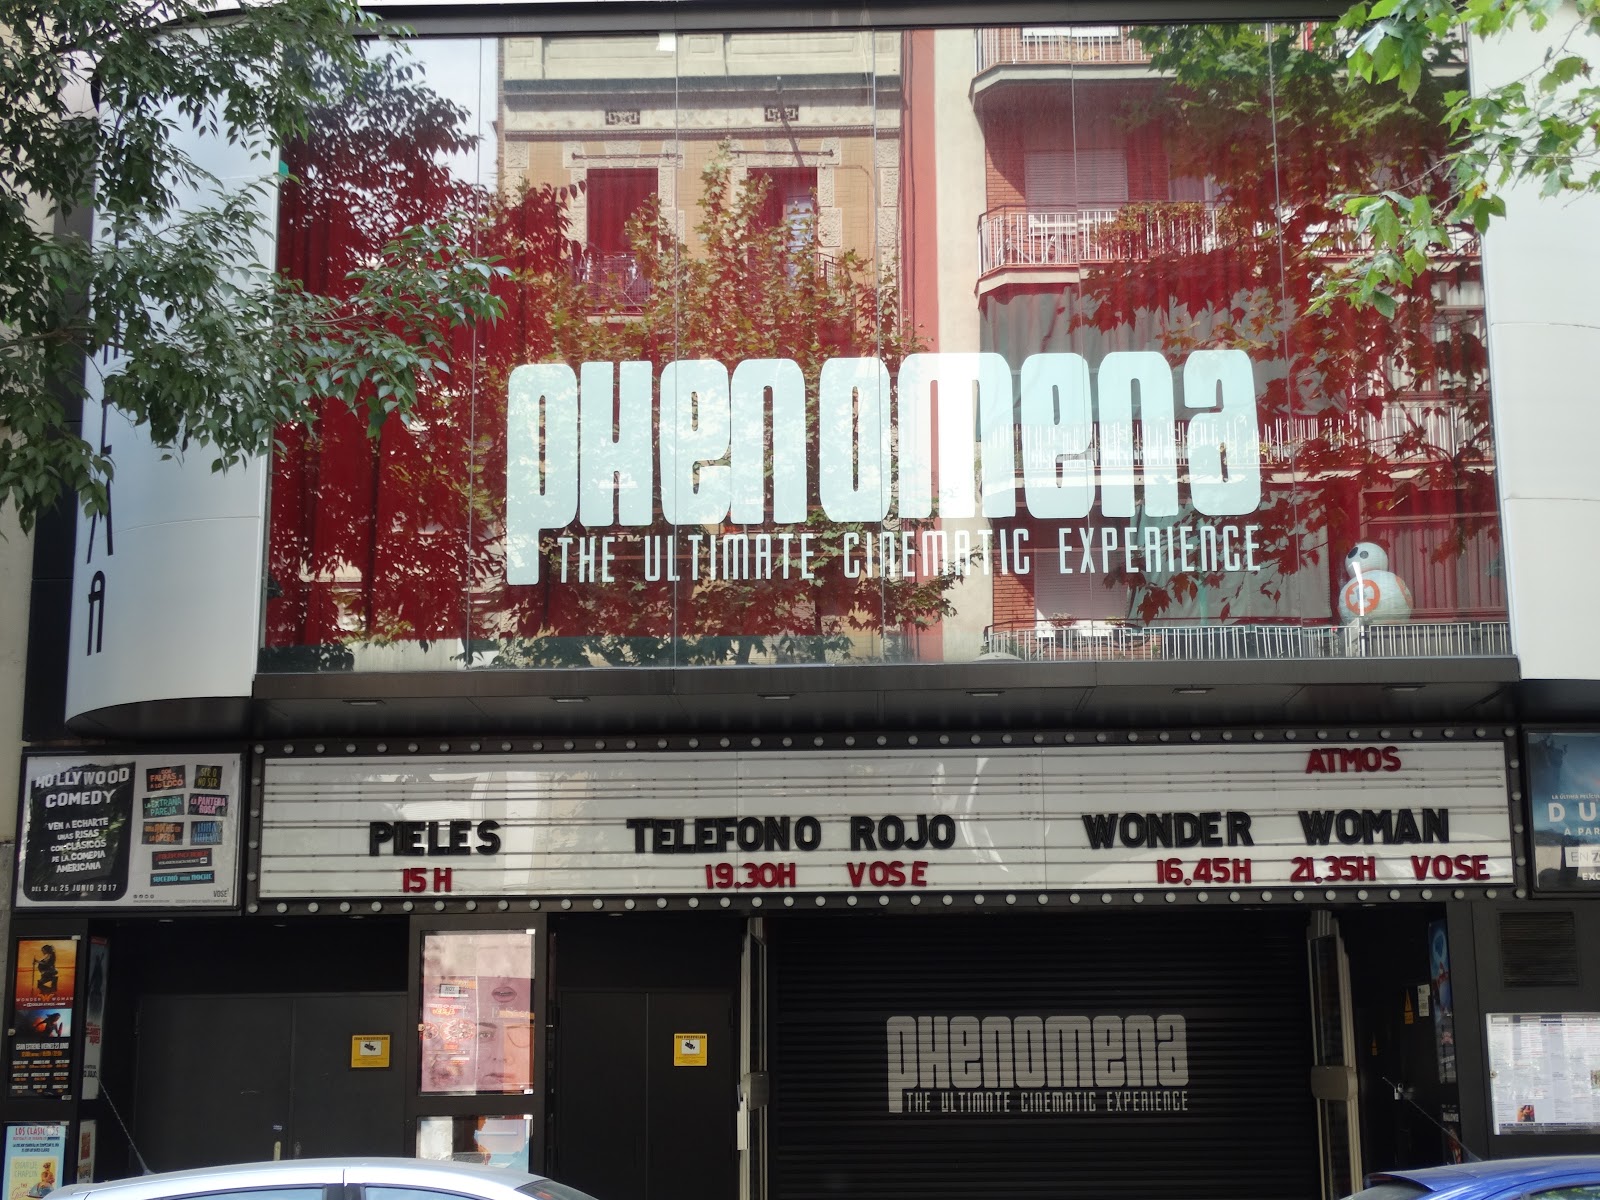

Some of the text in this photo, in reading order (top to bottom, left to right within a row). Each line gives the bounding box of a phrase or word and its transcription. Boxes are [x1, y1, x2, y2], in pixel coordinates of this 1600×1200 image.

[557, 524, 1261, 583] THE ULTIMATE CINEMATIC EXPERIENCE
[1305, 746, 1402, 774] ATMOS
[35, 767, 130, 789] HOLLYWOOD
[162, 779, 184, 788] LOCO
[45, 789, 117, 809] COMEDY
[198, 796, 226, 807] PANTERA
[150, 806, 177, 816] PAREJA
[47, 817, 109, 831] VEN A ECHARTE
[1082, 808, 1449, 850] WONDER WOMAN
[57, 829, 100, 841] UNAS RISAS
[369, 814, 956, 856] PIELES TELEFONO ROJO
[1564, 827, 1571, 836] A
[65, 839, 107, 851] CLÁSICOS
[70, 850, 106, 861] COMEDIA
[56, 861, 101, 873] AMERICANA
[1156, 854, 1490, 884] 16.45H 21.35H VOSE
[402, 860, 928, 893] 15H 19.30H VOSE
[43, 884, 49, 892] 3
[72, 884, 94, 892] JUNIO
[97, 883, 118, 892] 2017
[906, 1090, 1188, 1113] THE ULTIMATE CINEMATIC EXPERIENCE
[15, 1127, 25, 1136] LOS
